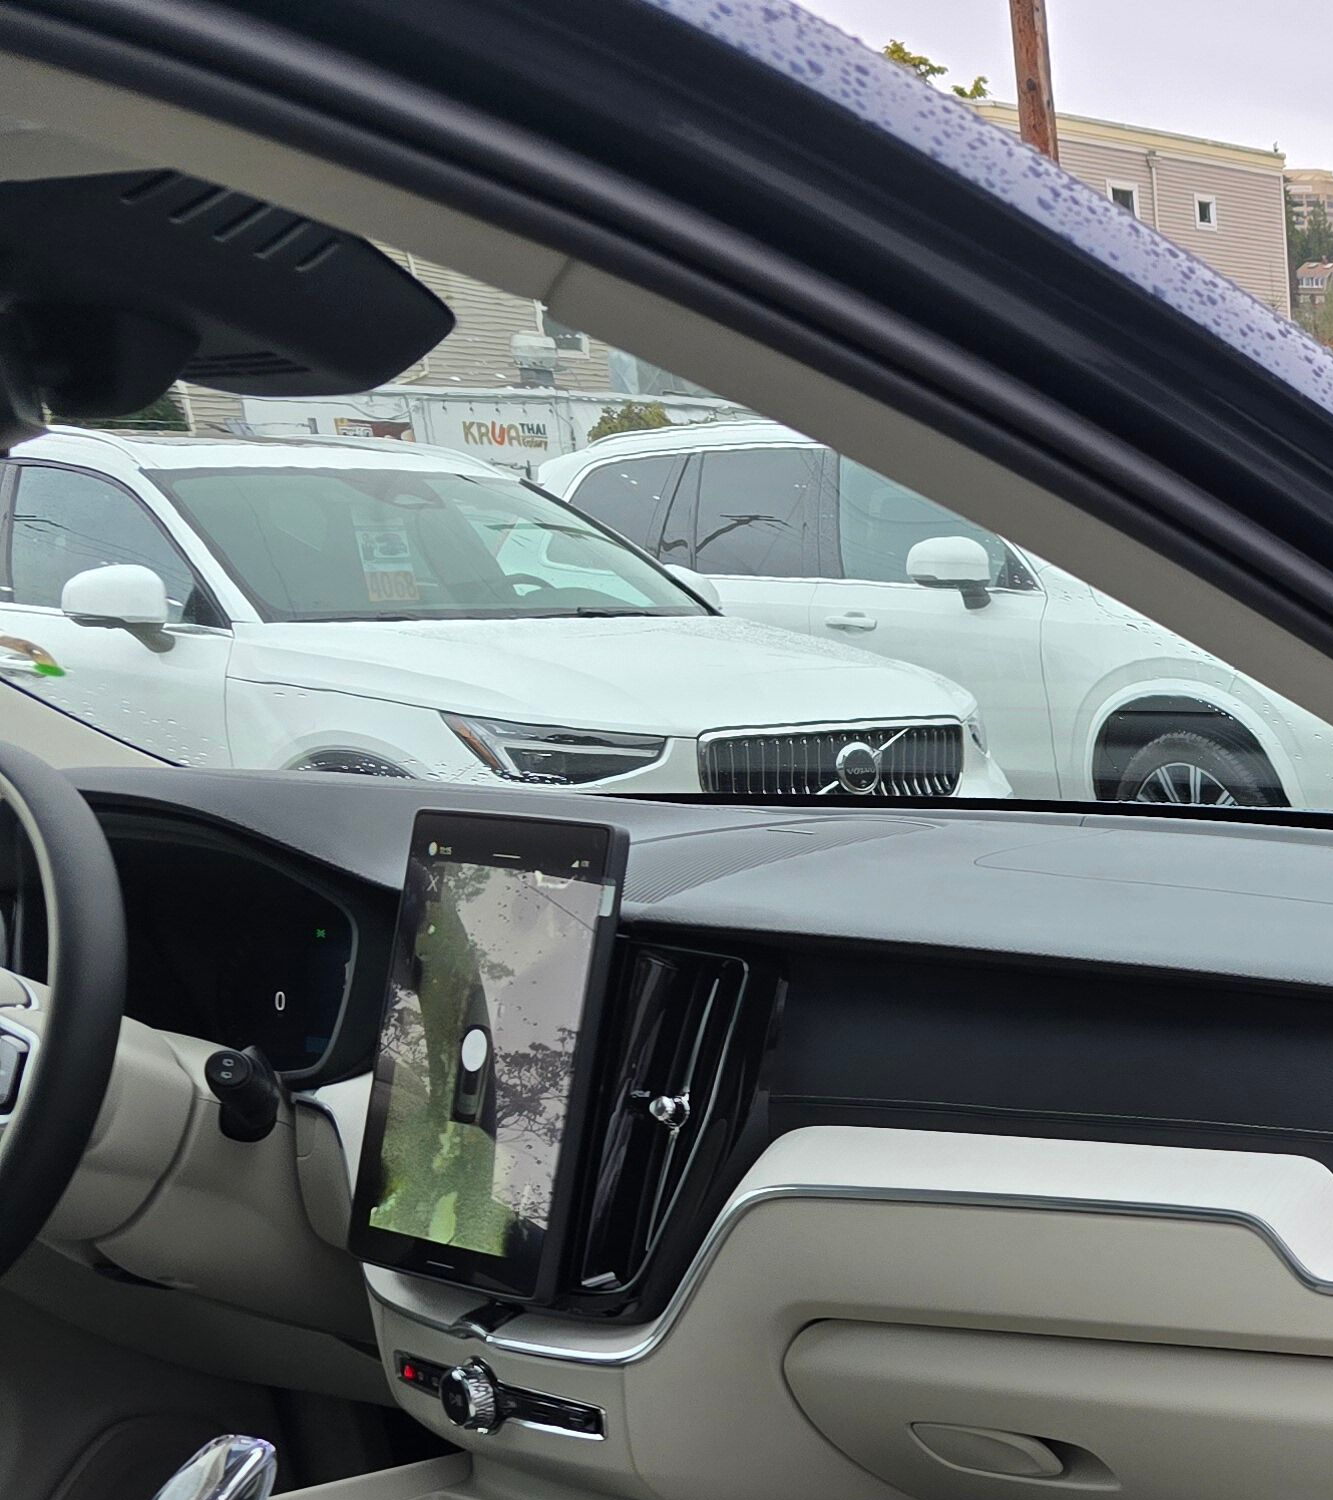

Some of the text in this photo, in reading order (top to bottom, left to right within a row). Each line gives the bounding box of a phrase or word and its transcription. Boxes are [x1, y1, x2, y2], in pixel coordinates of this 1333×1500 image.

[462, 420, 546, 447] KRUA THAI
[371, 573, 417, 599] 4068
[274, 991, 286, 1011] 0
